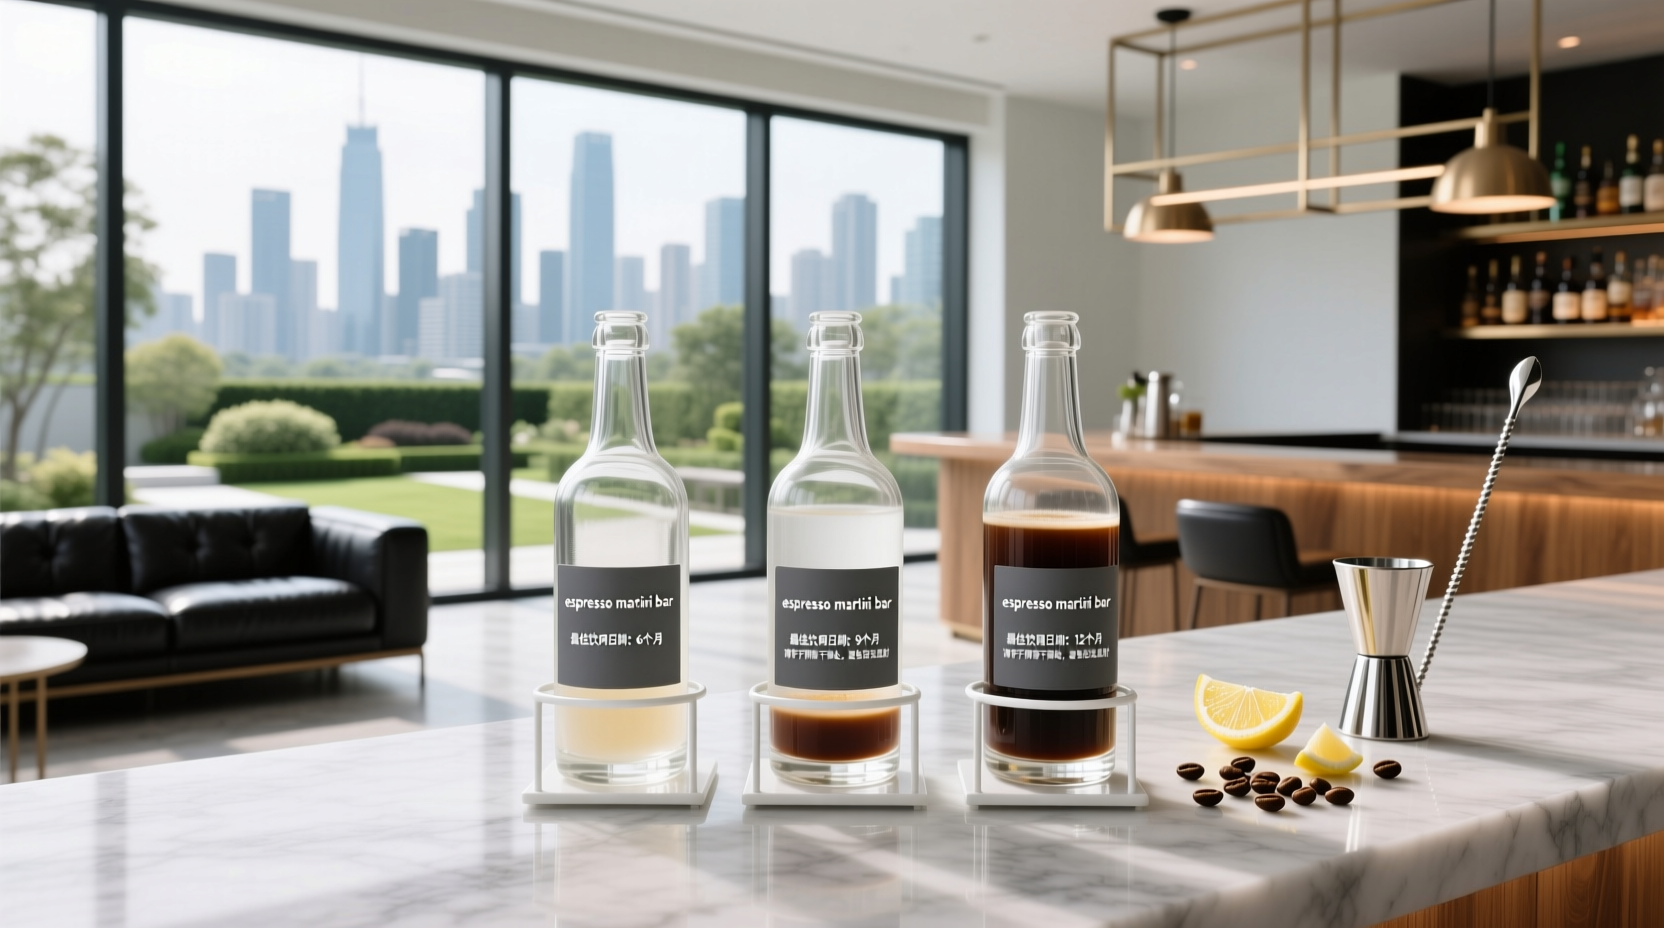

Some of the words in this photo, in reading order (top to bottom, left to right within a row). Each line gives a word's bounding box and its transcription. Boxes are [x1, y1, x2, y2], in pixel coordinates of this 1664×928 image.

[565, 597, 613, 612] espresso
[655, 594, 674, 608] bar
[782, 599, 831, 612] espresso
[874, 596, 893, 610] bar
[1002, 598, 1053, 612] espresso
[1094, 595, 1112, 609] bar
